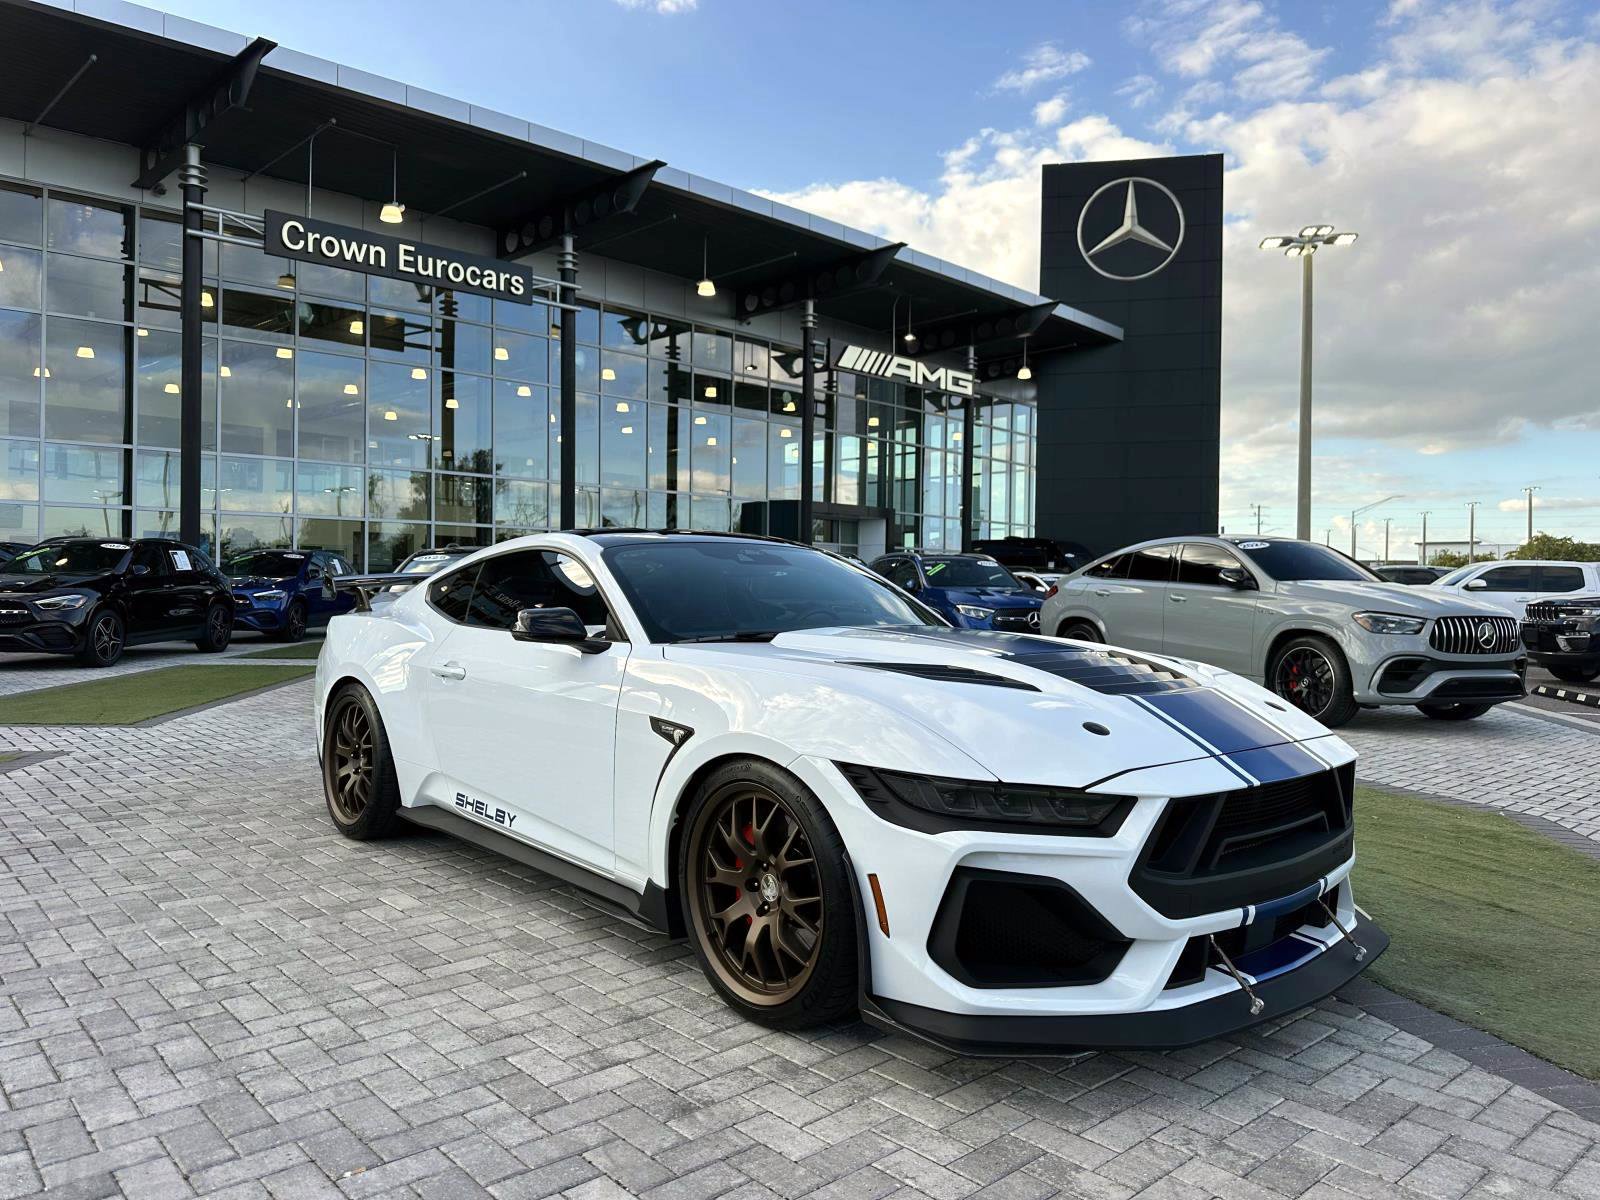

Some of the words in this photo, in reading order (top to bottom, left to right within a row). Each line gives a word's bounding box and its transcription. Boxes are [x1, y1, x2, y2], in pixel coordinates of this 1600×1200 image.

[281, 220, 386, 268] Crown
[399, 243, 524, 296] Eurocars
[884, 355, 973, 396] AMG
[455, 792, 517, 828] SHELBY
